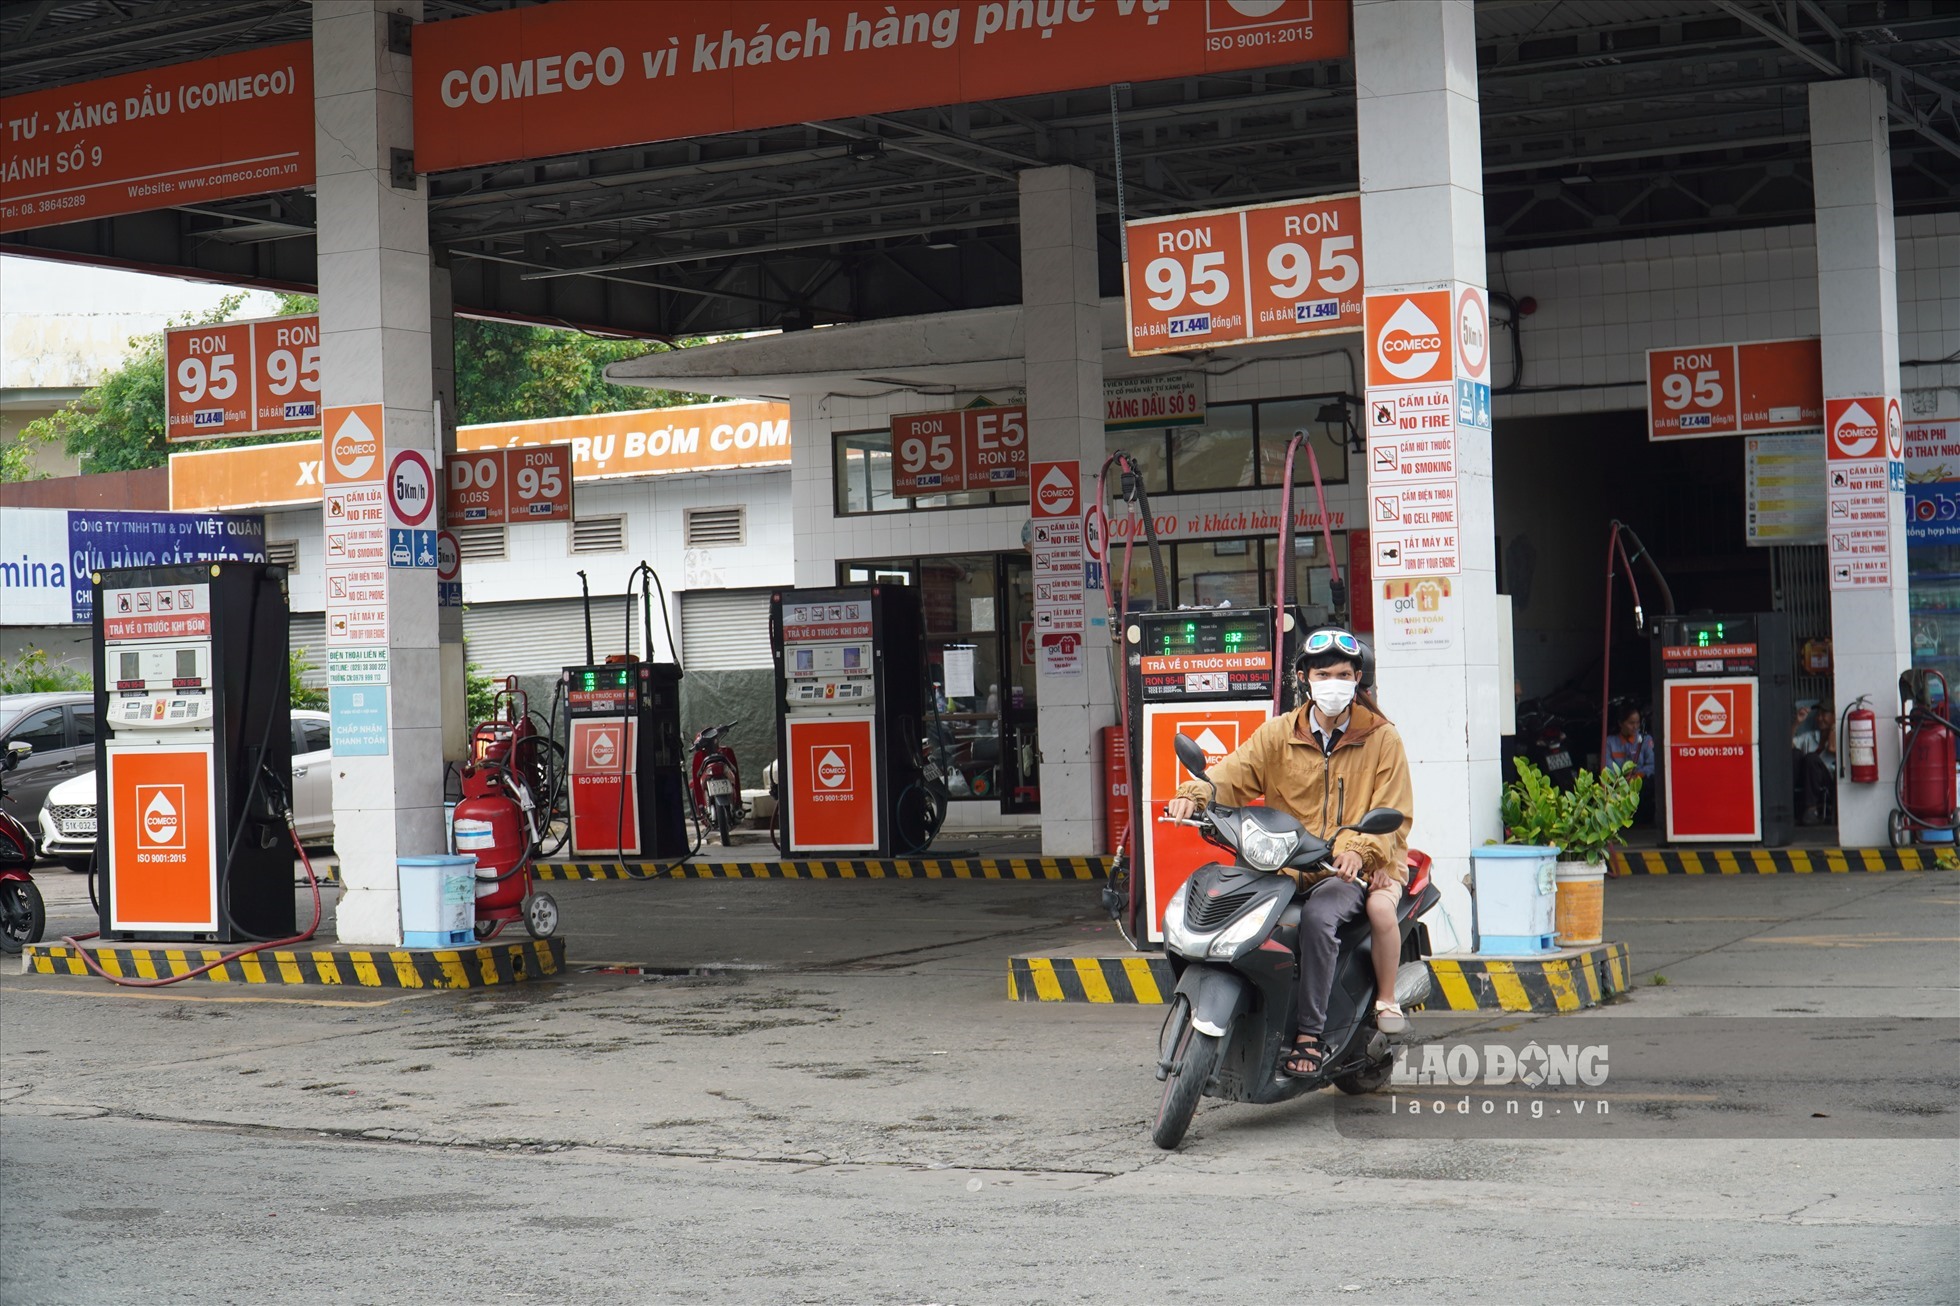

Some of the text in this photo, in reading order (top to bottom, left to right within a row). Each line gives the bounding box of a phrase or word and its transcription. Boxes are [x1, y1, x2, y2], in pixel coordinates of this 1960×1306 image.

[1206, 26, 1314, 51] ISO 9001:2015
[440, 0, 1096, 108] COMECO vì khách hàng phục
[9, 66, 296, 141] TƯ XĂNG DẦU (COMECO)
[56, 139, 86, 174] SỐ
[91, 146, 103, 167] 9
[127, 163, 298, 198] Website: www.comeco.com.vn
[1, 205, 19, 218] Tel:
[38, 194, 86, 213] 38645289
[1285, 211, 1339, 237] RON
[1158, 227, 1212, 253] RON
[1267, 235, 1360, 299] 95
[1145, 251, 1230, 311] 95
[1260, 308, 1274, 322] GIÁ
[277, 326, 317, 347] RON
[1134, 325, 1149, 337] GIÁ
[189, 335, 226, 355] RON
[1384, 338, 1441, 352] COMECO
[1674, 354, 1712, 370] RON
[266, 346, 321, 396] 95
[177, 354, 238, 403] 95
[1662, 370, 1724, 410] 95
[1108, 391, 1196, 419] XĂNG DẦU SỐ 9
[1399, 391, 1449, 407] CẤM LỬA
[911, 420, 943, 435] RON
[1400, 414, 1450, 430] NO FIRE
[977, 412, 1025, 449] E5
[1838, 427, 1879, 438] COMECO
[1931, 426, 1946, 440] PHÍ
[624, 419, 790, 457] BƠM COM
[336, 443, 376, 455] COMECO
[1401, 440, 1415, 453] CẤM
[1417, 440, 1428, 451] HÚT
[1915, 445, 1938, 458] THAY
[526, 453, 552, 466] RON
[901, 435, 954, 473] 95
[978, 450, 1025, 465] RON 92
[452, 458, 497, 490] DO
[1401, 461, 1452, 474] NO SMOKING
[1850, 467, 1867, 475] CẤM
[517, 467, 562, 499] 95
[1850, 481, 1885, 490] NO FIRE
[347, 488, 382, 502] CẤM LỬA
[460, 491, 489, 504] 0,05S
[1041, 489, 1074, 498] COMECO
[347, 509, 383, 521] NO FIRE
[1403, 511, 1453, 524] NO CELL PHONE
[72, 517, 262, 538] CÔNG TY TNHH TM & DV VIỆT QUÂN
[1051, 521, 1079, 531] CẤM LỬA
[1108, 515, 1178, 538] COMCO
[1188, 514, 1200, 533] vì
[1204, 512, 1247, 532] khách
[1251, 509, 1281, 531] hàn
[1051, 535, 1080, 544] NO FIRE
[1444, 537, 1454, 546] XE
[348, 548, 383, 558] NO SMOKING
[1871, 545, 1887, 553] PHONE
[0, 554, 66, 588] mina
[1060, 563, 1081, 571] SMOKING
[349, 590, 384, 600] NO CELL PHONE
[1395, 595, 1432, 613] got it
[377, 612, 384, 620] XE
[110, 622, 123, 635] TRẢ
[172, 620, 185, 632] KHI
[1049, 645, 1060, 655] got
[1147, 657, 1266, 670] TRẢ VỀ 0 TRƯỚC KHI BƠM
[1145, 676, 1164, 686] RON
[1229, 673, 1248, 682] RON
[1699, 713, 1727, 722] COMECO
[337, 723, 358, 734] CHẤP
[363, 735, 385, 744] TOÁN
[1679, 747, 1744, 757] ISO 9001:2015
[821, 767, 846, 775] COMECO
[825, 794, 854, 802] 9001:2015
[147, 816, 177, 826] COMECO
[137, 853, 187, 863] ISO 9001:2015
